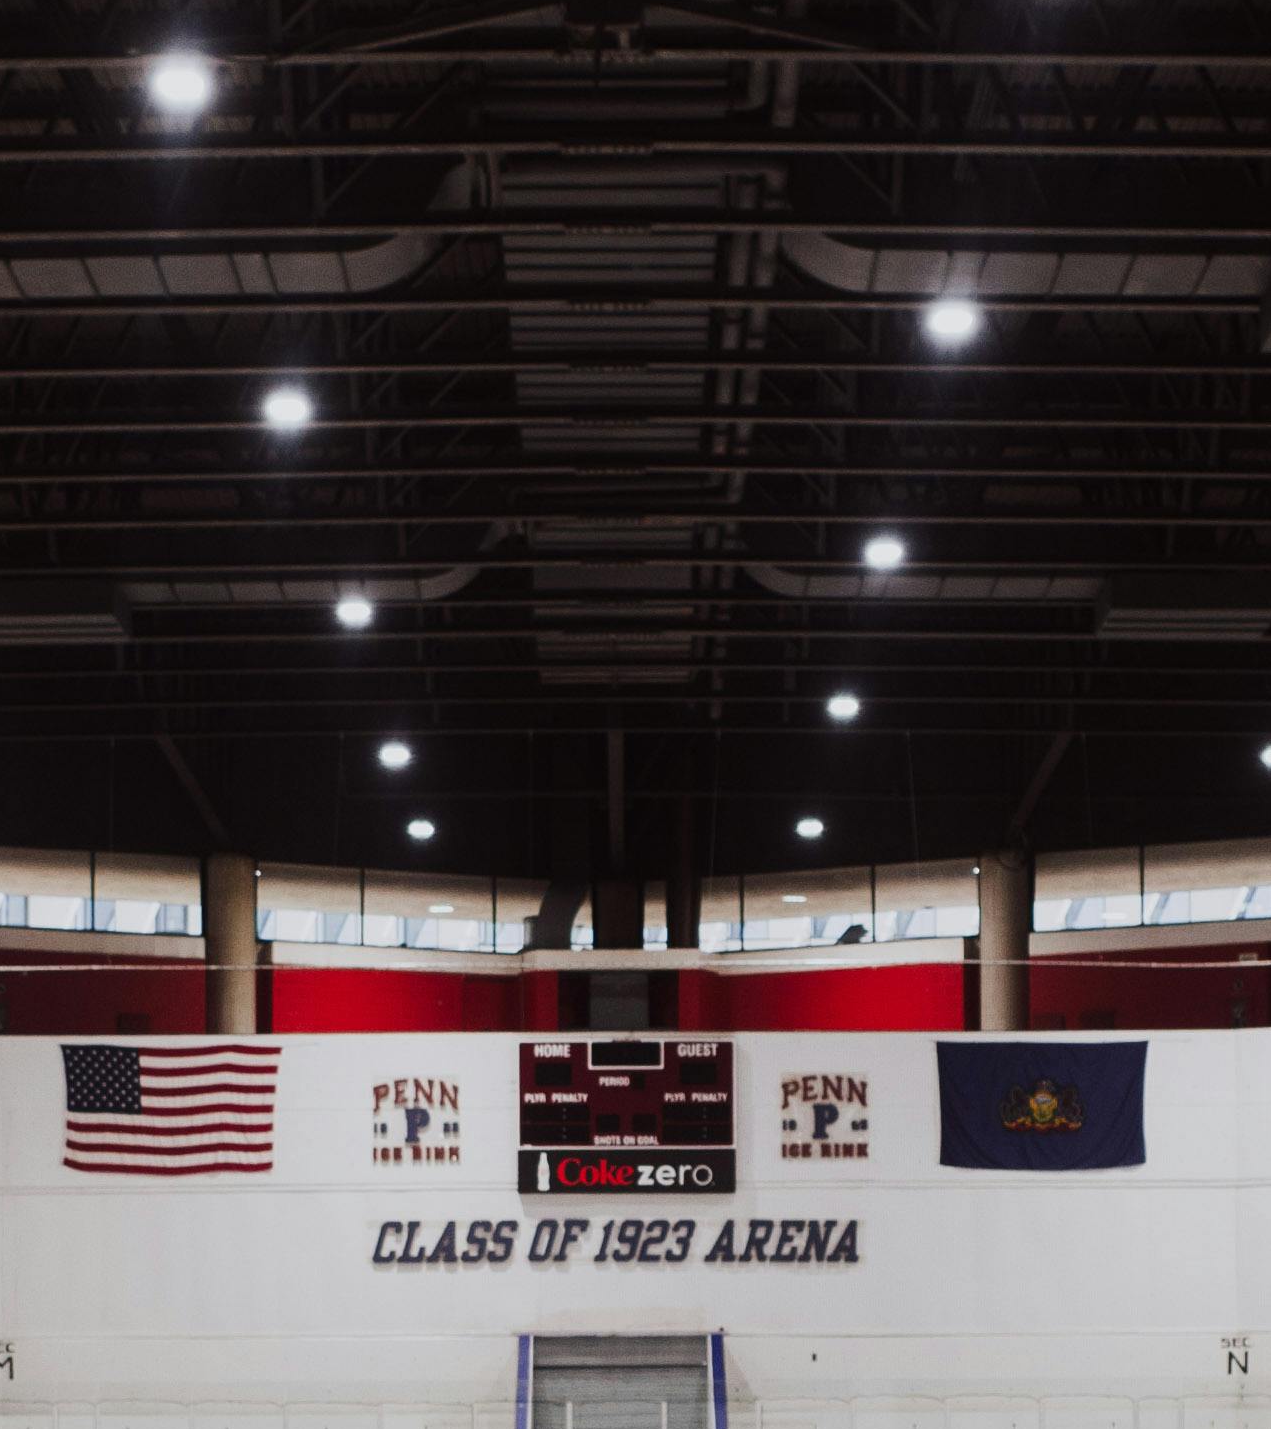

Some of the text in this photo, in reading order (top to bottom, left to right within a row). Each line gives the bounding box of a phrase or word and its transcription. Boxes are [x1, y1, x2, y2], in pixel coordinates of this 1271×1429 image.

[534, 1044, 571, 1058] HOME
[677, 1043, 719, 1057] GUEST
[598, 1076, 631, 1087] PERIOD
[373, 1078, 459, 1113] PENN
[524, 1093, 589, 1104] PLYR PENALTY
[664, 1092, 728, 1103] PLYR PENALTY
[781, 1075, 868, 1110] PENN
[404, 1108, 431, 1143] P
[812, 1103, 839, 1140] P
[593, 1135, 660, 1146] SHOTS ON GOAL
[373, 1145, 460, 1162] ICE RINK
[781, 1143, 869, 1158] ICE RINK
[557, 1158, 714, 1187] Coke zero
[371, 1220, 860, 1264] CLASS OF 1923 ARENA
[1221, 1337, 1252, 1349] SEC
[1228, 1351, 1249, 1375] N
